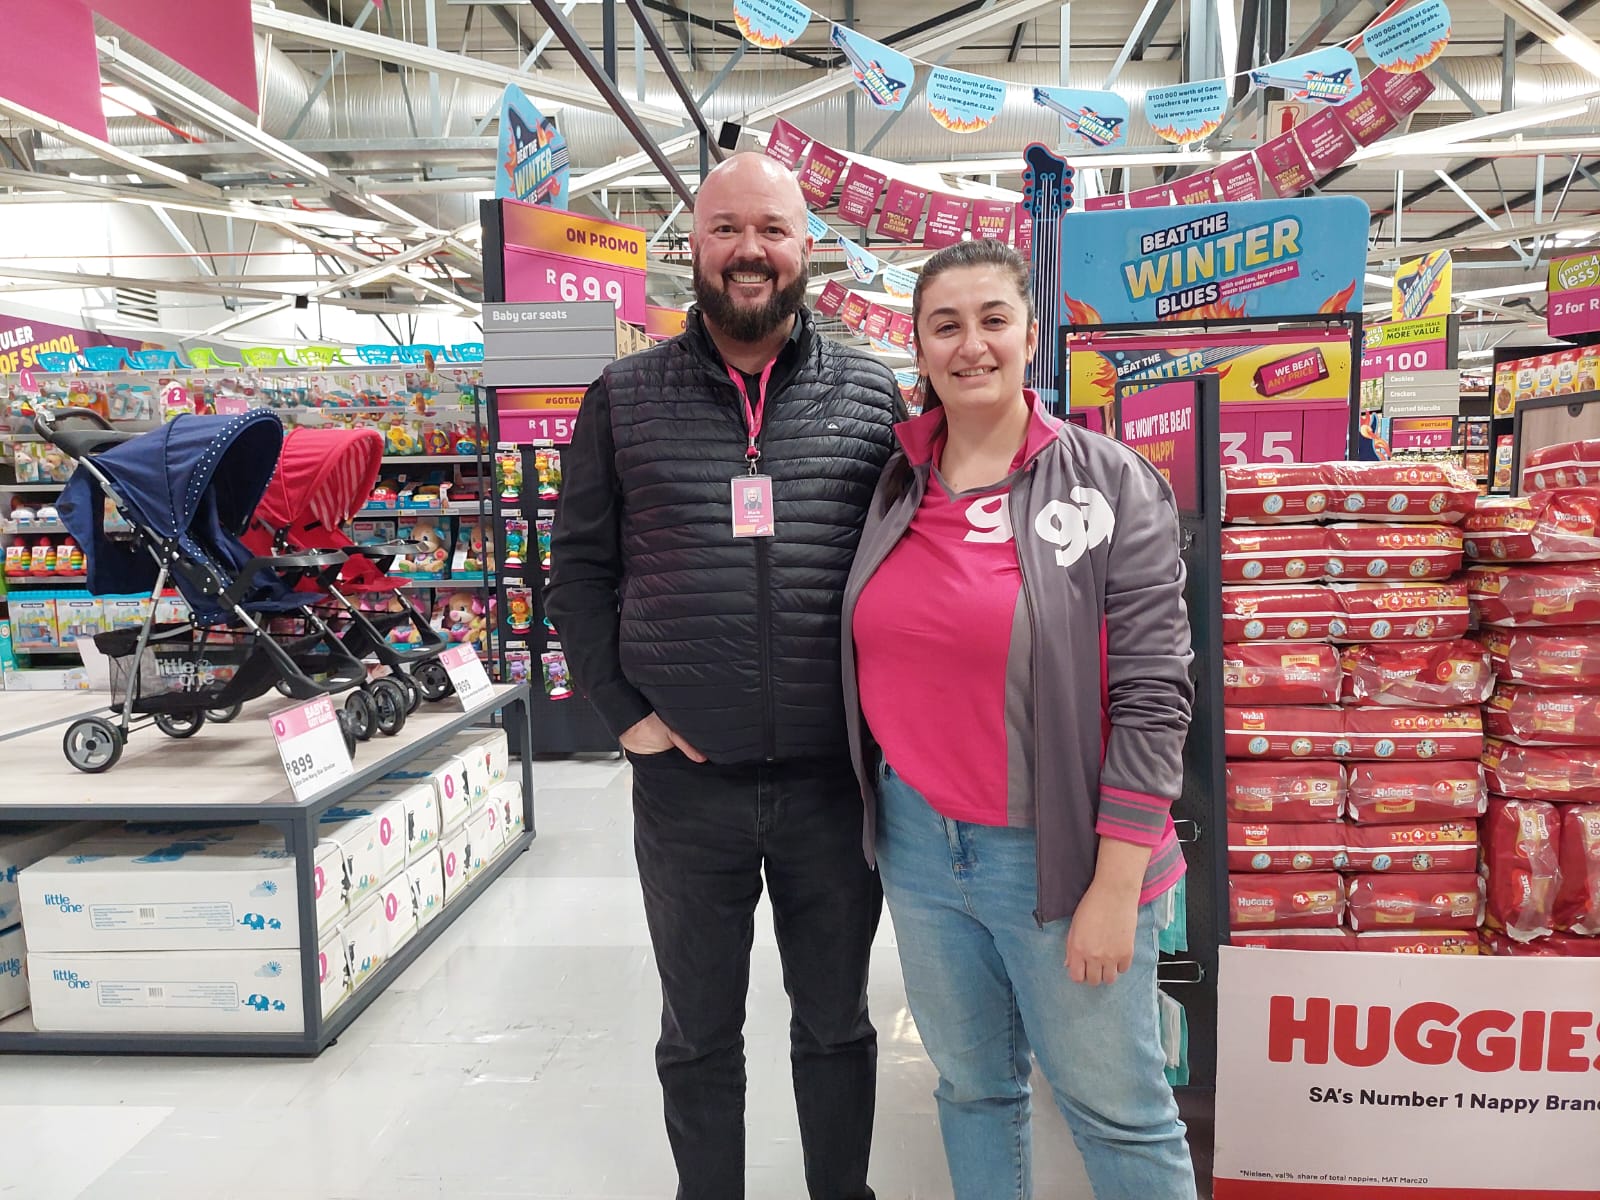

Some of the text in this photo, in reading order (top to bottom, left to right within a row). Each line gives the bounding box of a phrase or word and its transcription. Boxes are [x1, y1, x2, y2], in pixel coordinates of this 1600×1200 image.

[753, 7, 794, 33] www.game.co.za
[1366, 31, 1383, 43] R100
[1383, 24, 1396, 34] 000
[1397, 15, 1415, 28] worth
[1422, 3, 1440, 14] Game
[1375, 31, 1402, 47] vouchers
[1420, 12, 1440, 25] grabs.
[1378, 48, 1393, 58] Visit
[1394, 22, 1445, 51] www.game.co.za
[934, 73, 949, 81] R100
[962, 79, 978, 87] worth
[986, 84, 1003, 92] Game
[936, 83, 962, 92] vouchers
[1179, 89, 1197, 97] worth
[1205, 85, 1222, 93] Game
[1306, 80, 1347, 95] WINTER
[934, 92, 946, 101] Visit
[947, 97, 995, 111] www.game.co.za
[1153, 100, 1181, 108] vouchers
[1346, 96, 1374, 120] WIN
[1169, 105, 1220, 117] www.game.co.za
[1078, 116, 1114, 141] WINTER
[516, 144, 529, 165] BEAT
[514, 147, 552, 198] WINTER
[811, 158, 836, 180] WIN
[811, 170, 831, 185] TROLLEY
[1275, 164, 1301, 181] TROLLEY
[1228, 174, 1244, 184] ENTRY
[1182, 188, 1210, 205] WIN
[887, 212, 912, 225] TROLLEY
[978, 215, 1006, 228] WIN
[566, 228, 639, 255] ON PROMO
[1142, 213, 1228, 253] BEAT THE
[1124, 218, 1301, 299] WINTER
[1269, 268, 1287, 278] prices
[1564, 260, 1589, 276] more
[1560, 268, 1595, 290] less
[1158, 283, 1219, 316] BLUES
[492, 310, 568, 323] Baby car seats
[1554, 303, 1563, 316] 2
[1565, 302, 1585, 314] for
[0, 326, 34, 351] ULER
[1386, 326, 1441, 340] MORE VALUE
[0, 351, 19, 375] OF
[1117, 353, 1161, 377] BEAT THE
[1275, 357, 1315, 377] WE BEAT
[1361, 350, 1427, 371] for R 100
[1267, 366, 1314, 389] ANY PRICE
[545, 396, 584, 406] #GOTGA
[1125, 406, 1192, 440] WE WON'T BE BEAT
[1150, 439, 1175, 462] NAPPY
[154, 658, 195, 676] little
[179, 669, 215, 688] one
[304, 701, 331, 717] BABY'S
[1235, 785, 1271, 795] HUGGIES
[1315, 782, 1328, 792] 62
[44, 893, 70, 905] little
[1238, 897, 1273, 906] HUGGIES
[60, 904, 82, 913] one
[0, 957, 19, 974] ittle
[53, 969, 78, 981] little
[68, 980, 90, 989] one
[1268, 995, 1600, 1072] HUGGIE
[1309, 1086, 1353, 1105] SA's
[1360, 1089, 1449, 1109] Number
[1454, 1093, 1463, 1108] 1
[1470, 1094, 1539, 1113] Nappy
[1275, 1172, 1293, 1180] val%
[1348, 1176, 1379, 1184] nappies,
